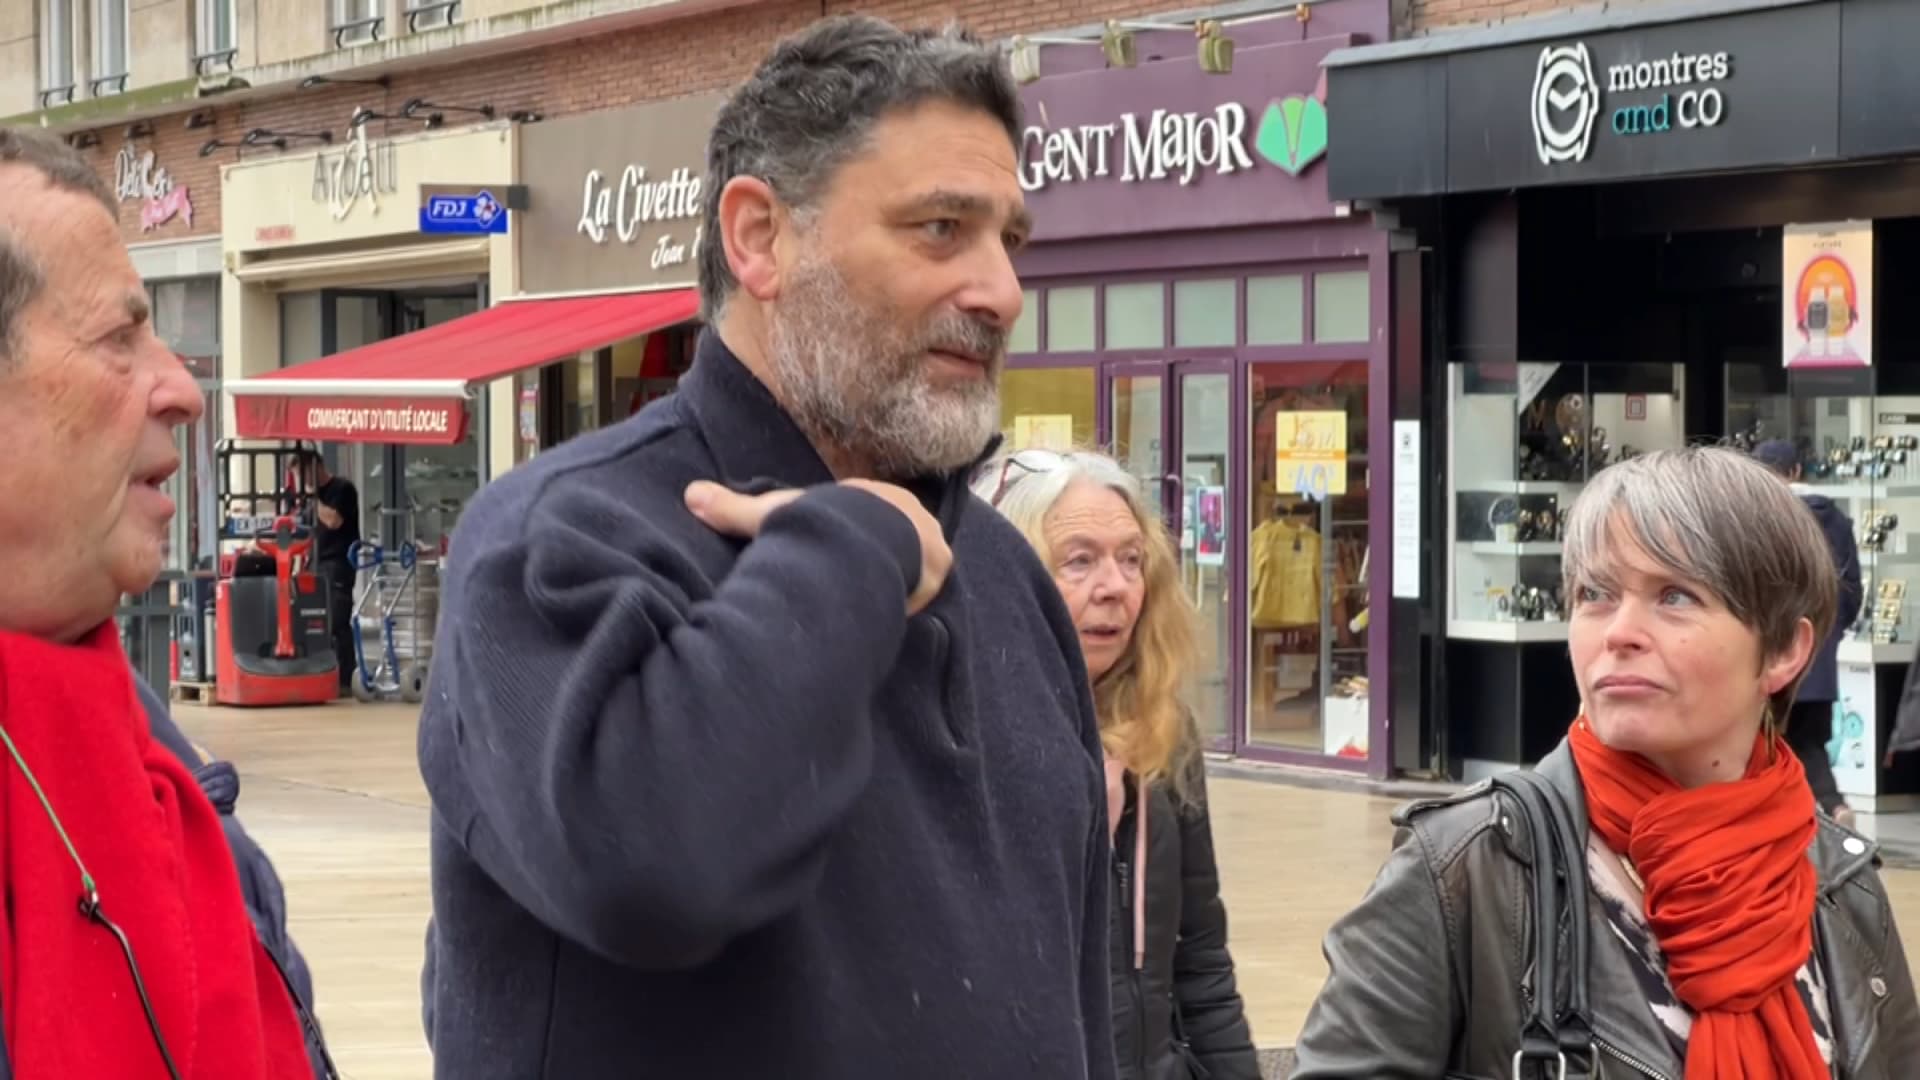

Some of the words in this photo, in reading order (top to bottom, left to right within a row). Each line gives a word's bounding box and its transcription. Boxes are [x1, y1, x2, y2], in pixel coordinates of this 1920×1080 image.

[1608, 51, 1729, 92] montres
[1612, 92, 1670, 134] and
[1677, 87, 1722, 128] CO
[432, 200, 466, 217] FDJ
[577, 169, 611, 243] La
[616, 164, 701, 243] Civette
[307, 407, 369, 434] COMMERÇANT
[370, 404, 413, 432] D'UTILITÉ
[413, 409, 448, 432] LOCALE
